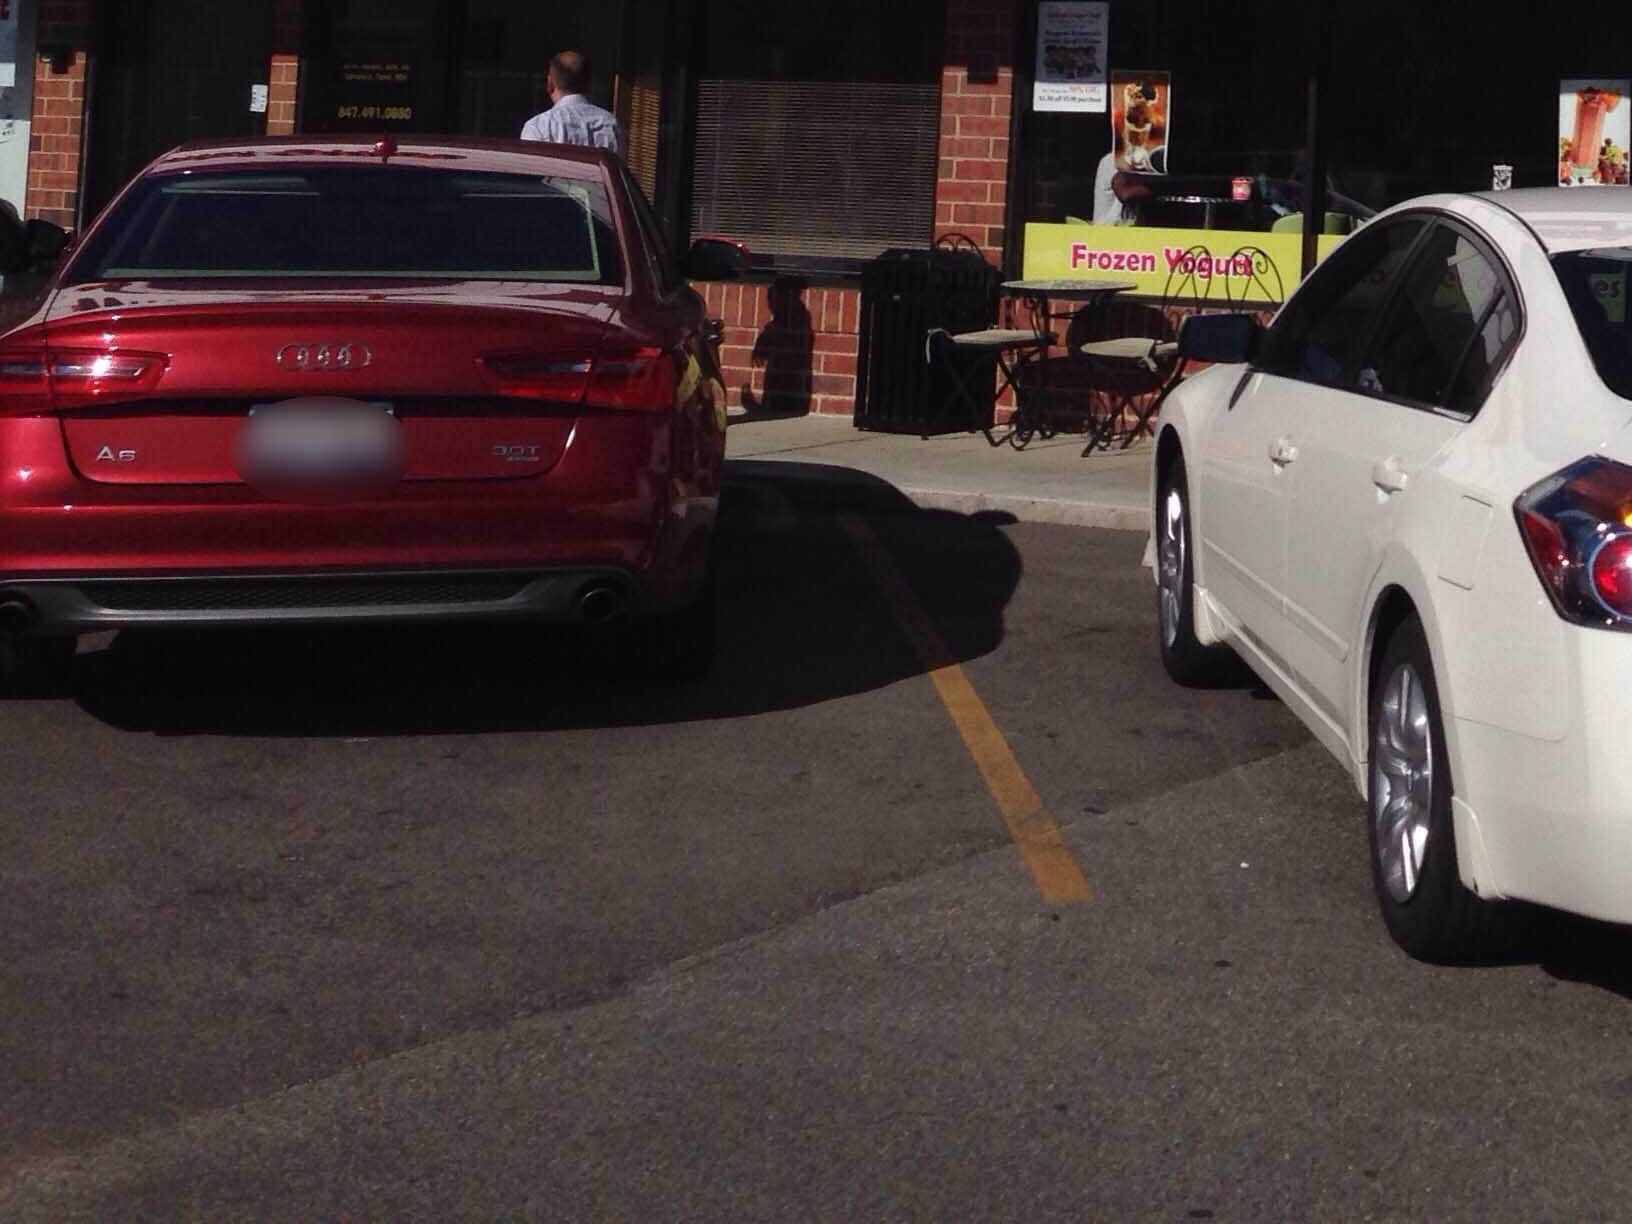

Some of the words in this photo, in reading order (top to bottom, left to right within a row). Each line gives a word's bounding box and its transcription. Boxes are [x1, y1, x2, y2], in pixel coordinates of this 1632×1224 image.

[1070, 244, 1156, 271] Frozen
[1163, 248, 1252, 278] Yogurt
[96, 445, 136, 462] A6
